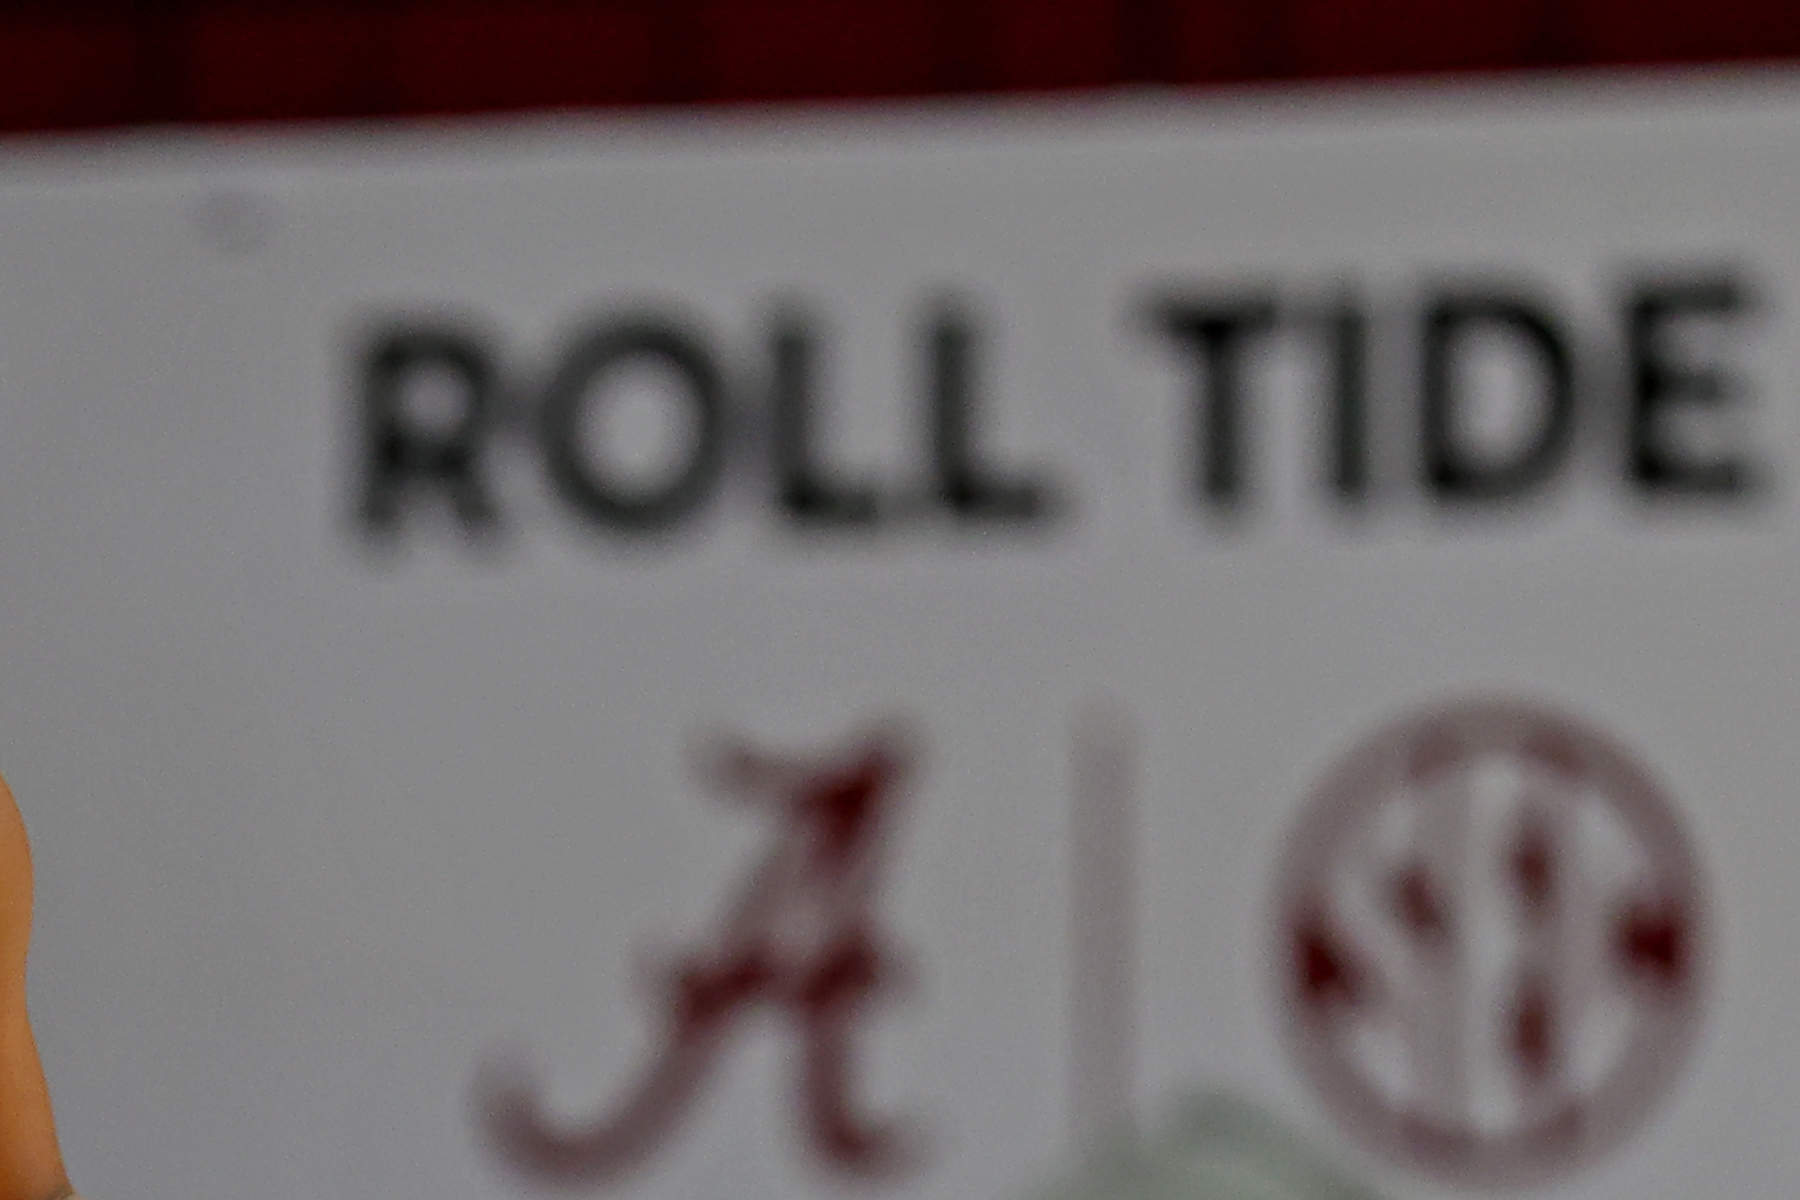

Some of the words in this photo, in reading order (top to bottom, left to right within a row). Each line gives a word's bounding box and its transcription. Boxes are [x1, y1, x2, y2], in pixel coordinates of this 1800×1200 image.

[353, 292, 1058, 545] ROLL
[1150, 272, 1754, 512] TIDE
[474, 722, 926, 1197] A
